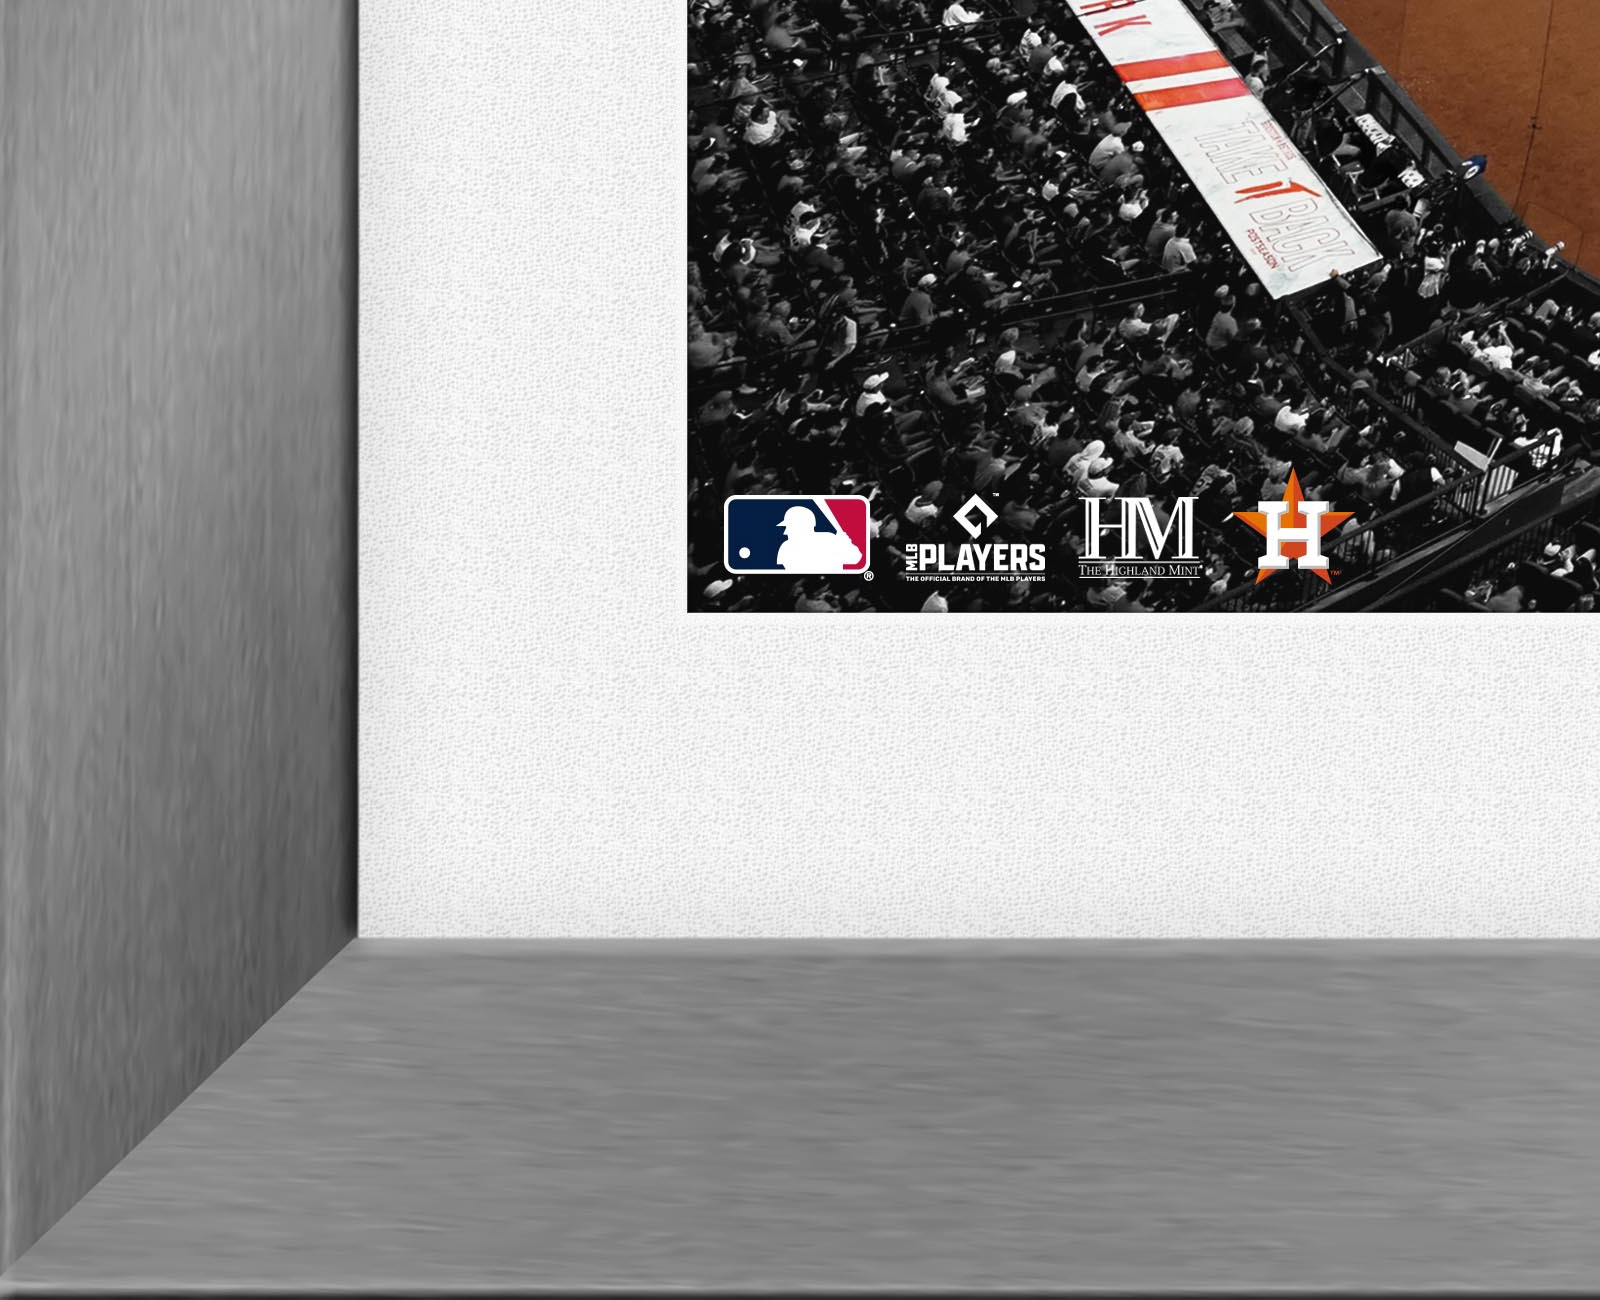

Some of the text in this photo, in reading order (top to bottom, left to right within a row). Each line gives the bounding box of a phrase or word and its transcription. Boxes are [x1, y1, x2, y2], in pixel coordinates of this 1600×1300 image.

[1194, 119, 1355, 273] TAKE BACK
[1247, 228, 1279, 270] POSTSEASON
